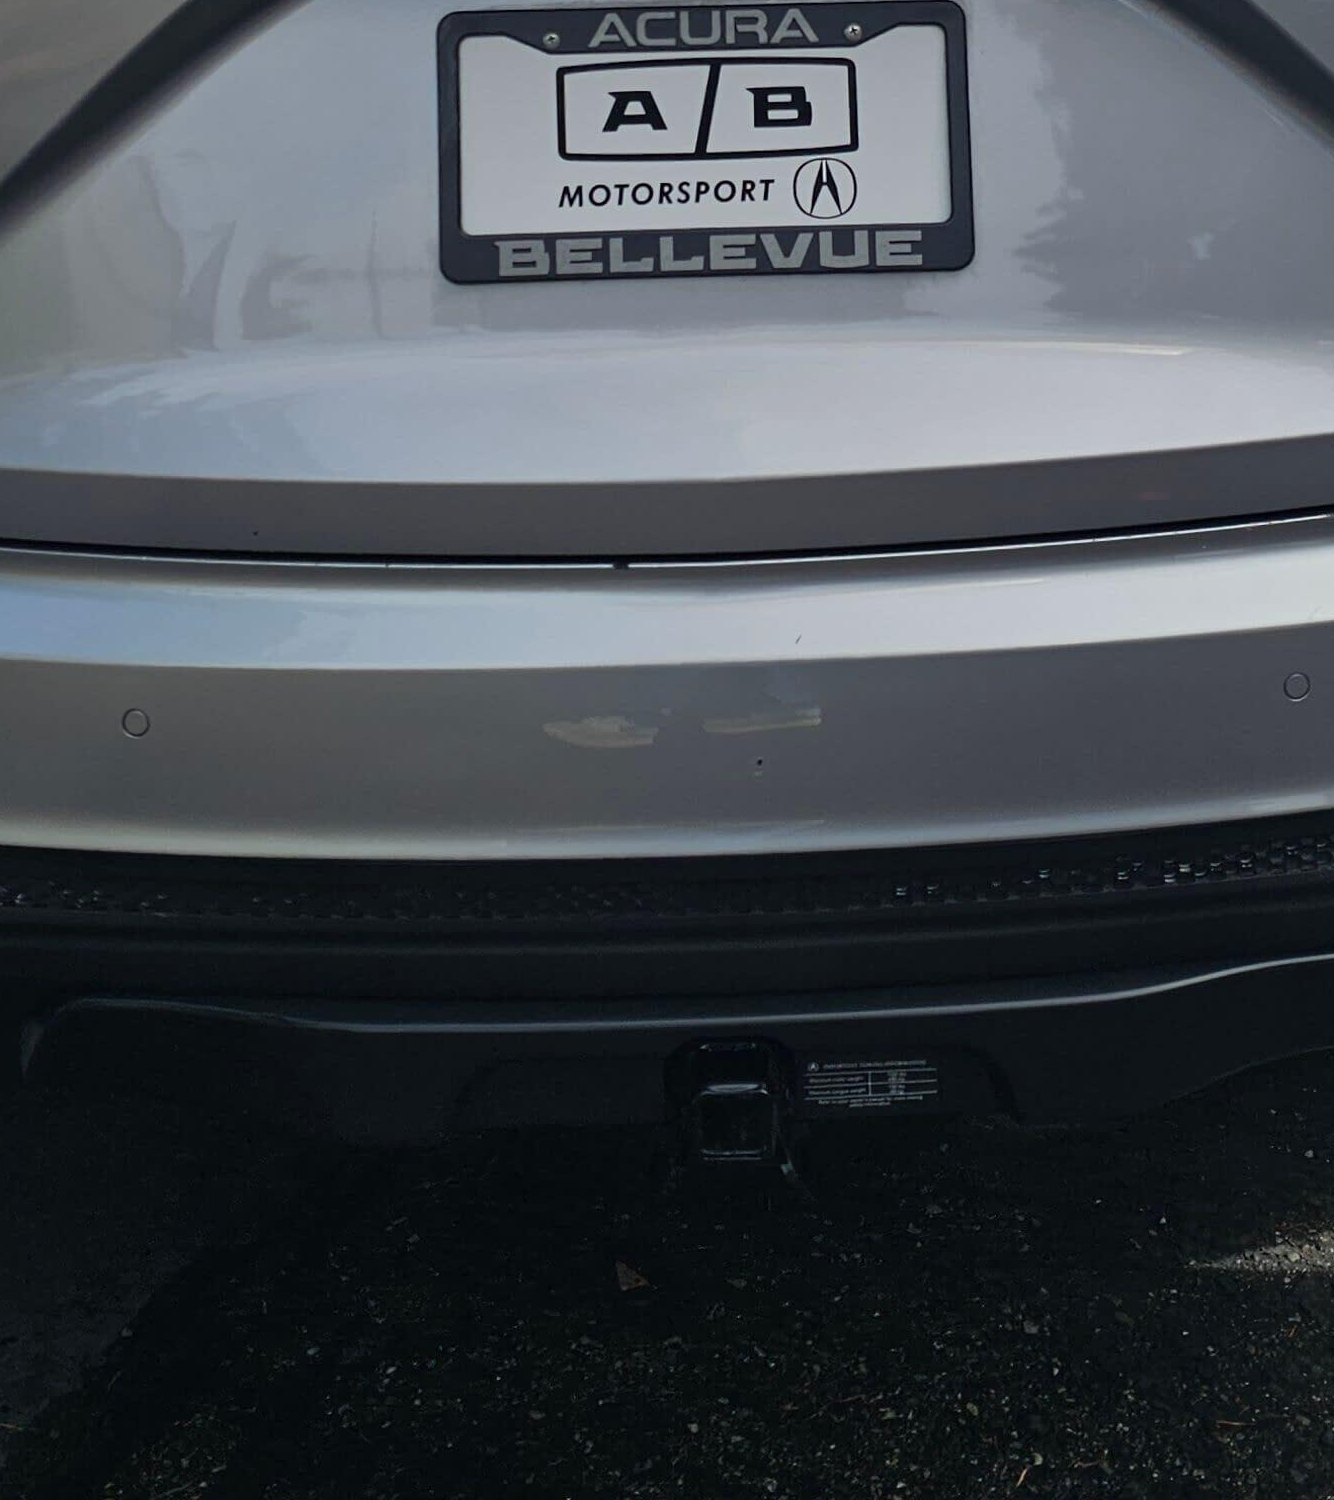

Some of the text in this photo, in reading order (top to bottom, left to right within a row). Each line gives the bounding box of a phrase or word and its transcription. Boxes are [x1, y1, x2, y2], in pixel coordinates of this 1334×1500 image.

[587, 7, 820, 48] ACURA
[602, 85, 813, 132] A B
[558, 178, 776, 209] MOTORSPORT
[493, 230, 924, 277] BELLEVUE
